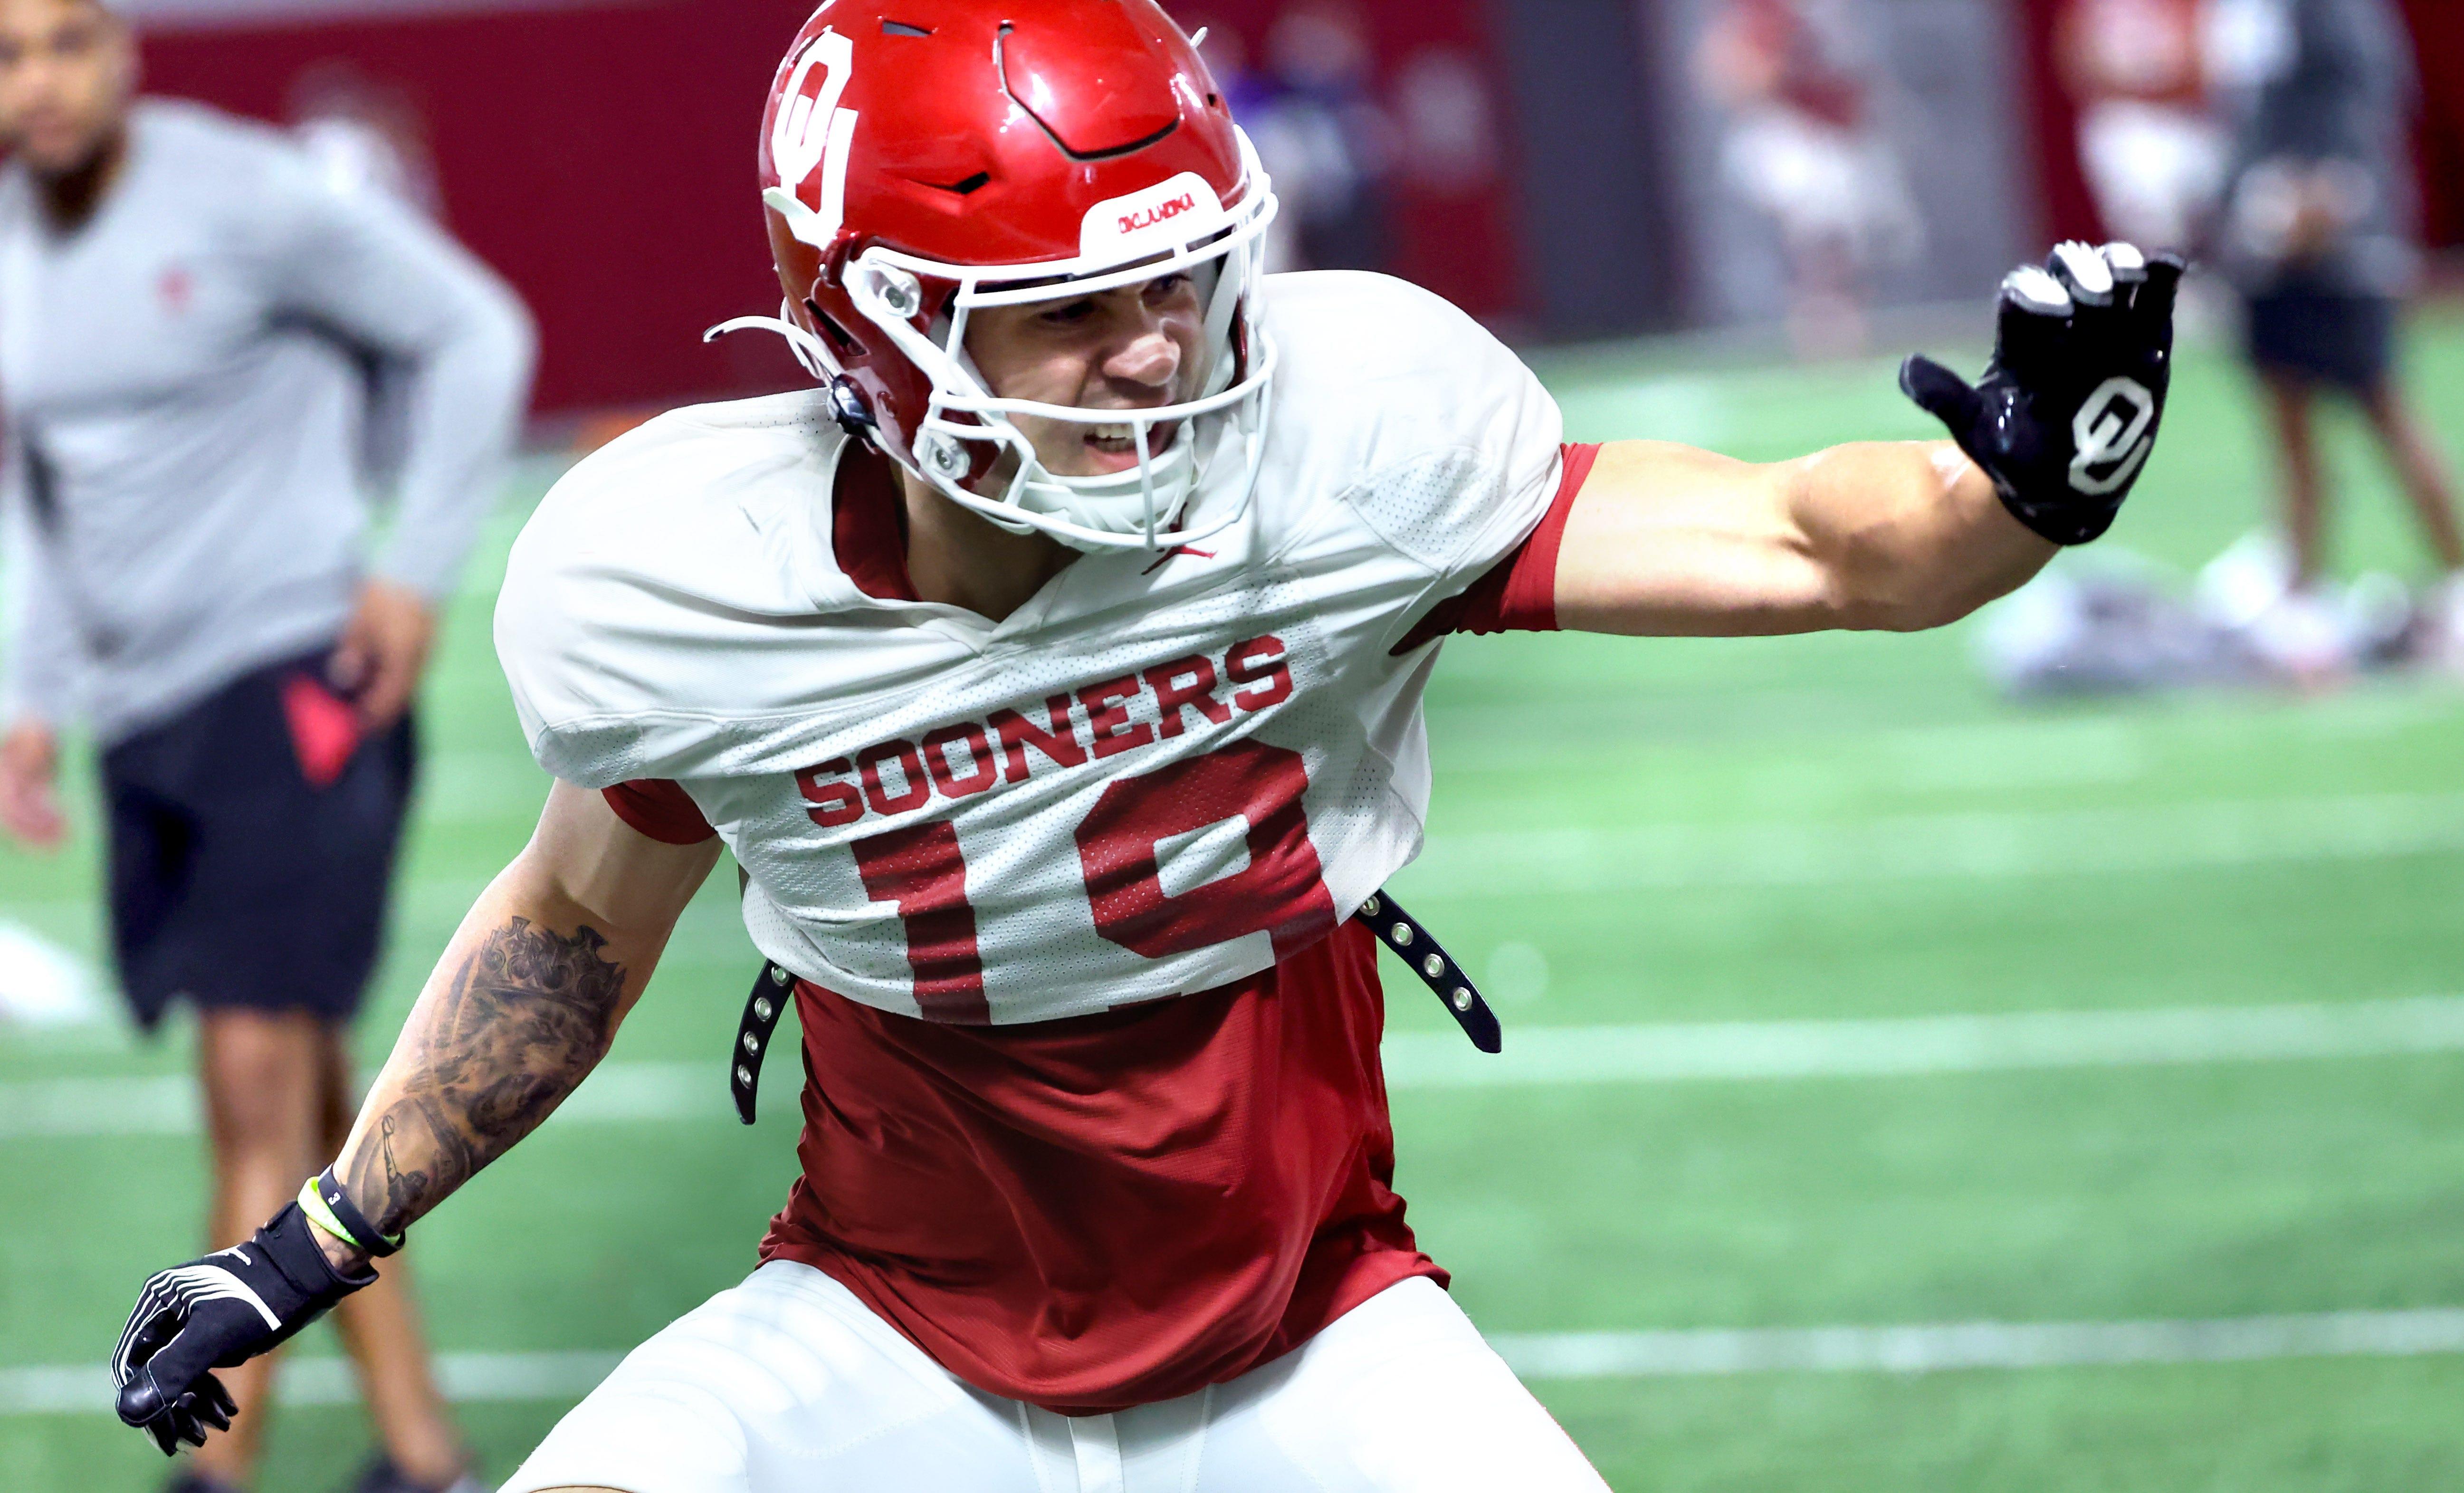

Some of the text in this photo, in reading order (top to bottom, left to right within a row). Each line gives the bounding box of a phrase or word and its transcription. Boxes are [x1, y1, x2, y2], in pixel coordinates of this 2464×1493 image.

[2068, 376, 2154, 496] OU
[795, 634, 1293, 828] SOONERS
[850, 737, 1338, 1025] 19
